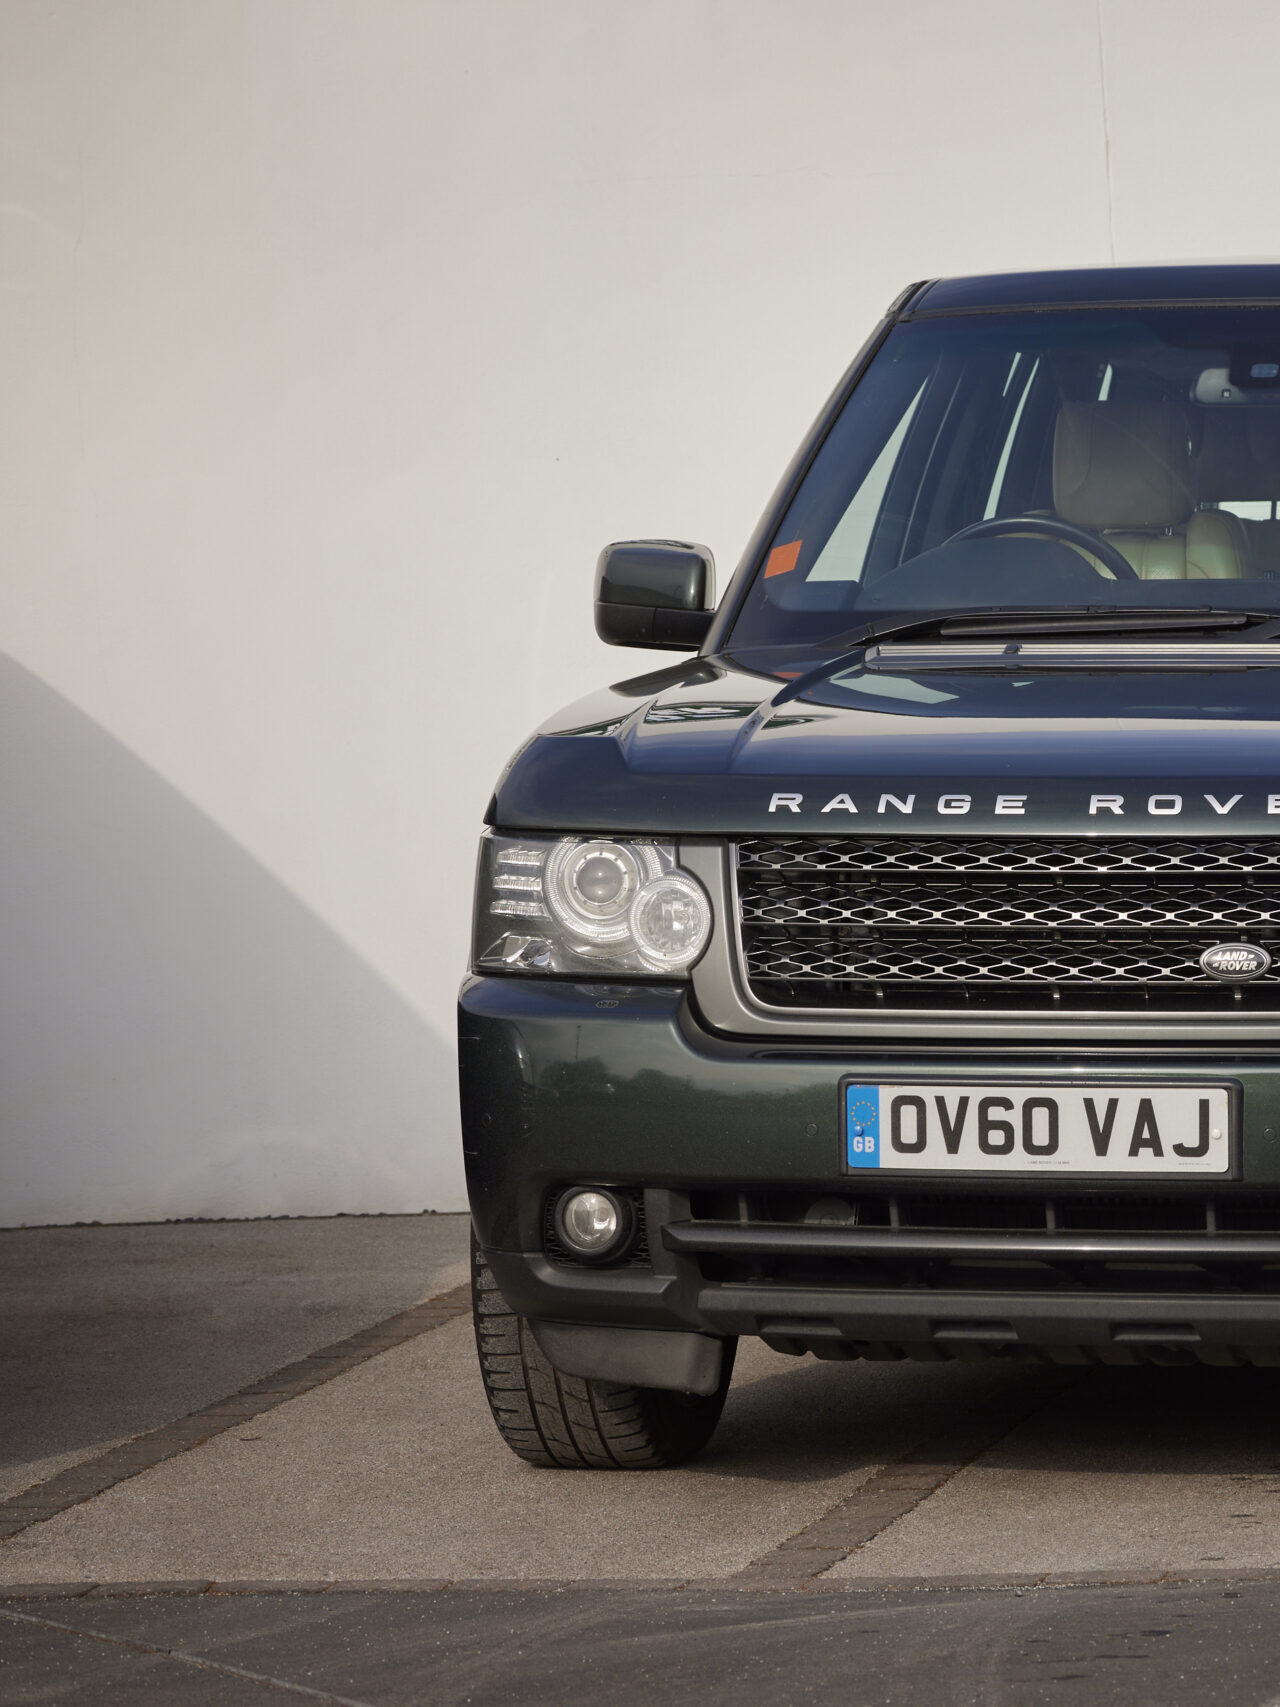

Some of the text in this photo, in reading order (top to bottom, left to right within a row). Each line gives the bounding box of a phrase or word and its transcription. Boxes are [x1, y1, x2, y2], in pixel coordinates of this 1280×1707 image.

[768, 793, 1028, 814] RANGE
[1216, 951, 1248, 960] LAND
[1219, 961, 1257, 971] ROVER
[890, 1095, 1210, 1158] OV60 VAJ
[853, 1136, 875, 1153] GB
